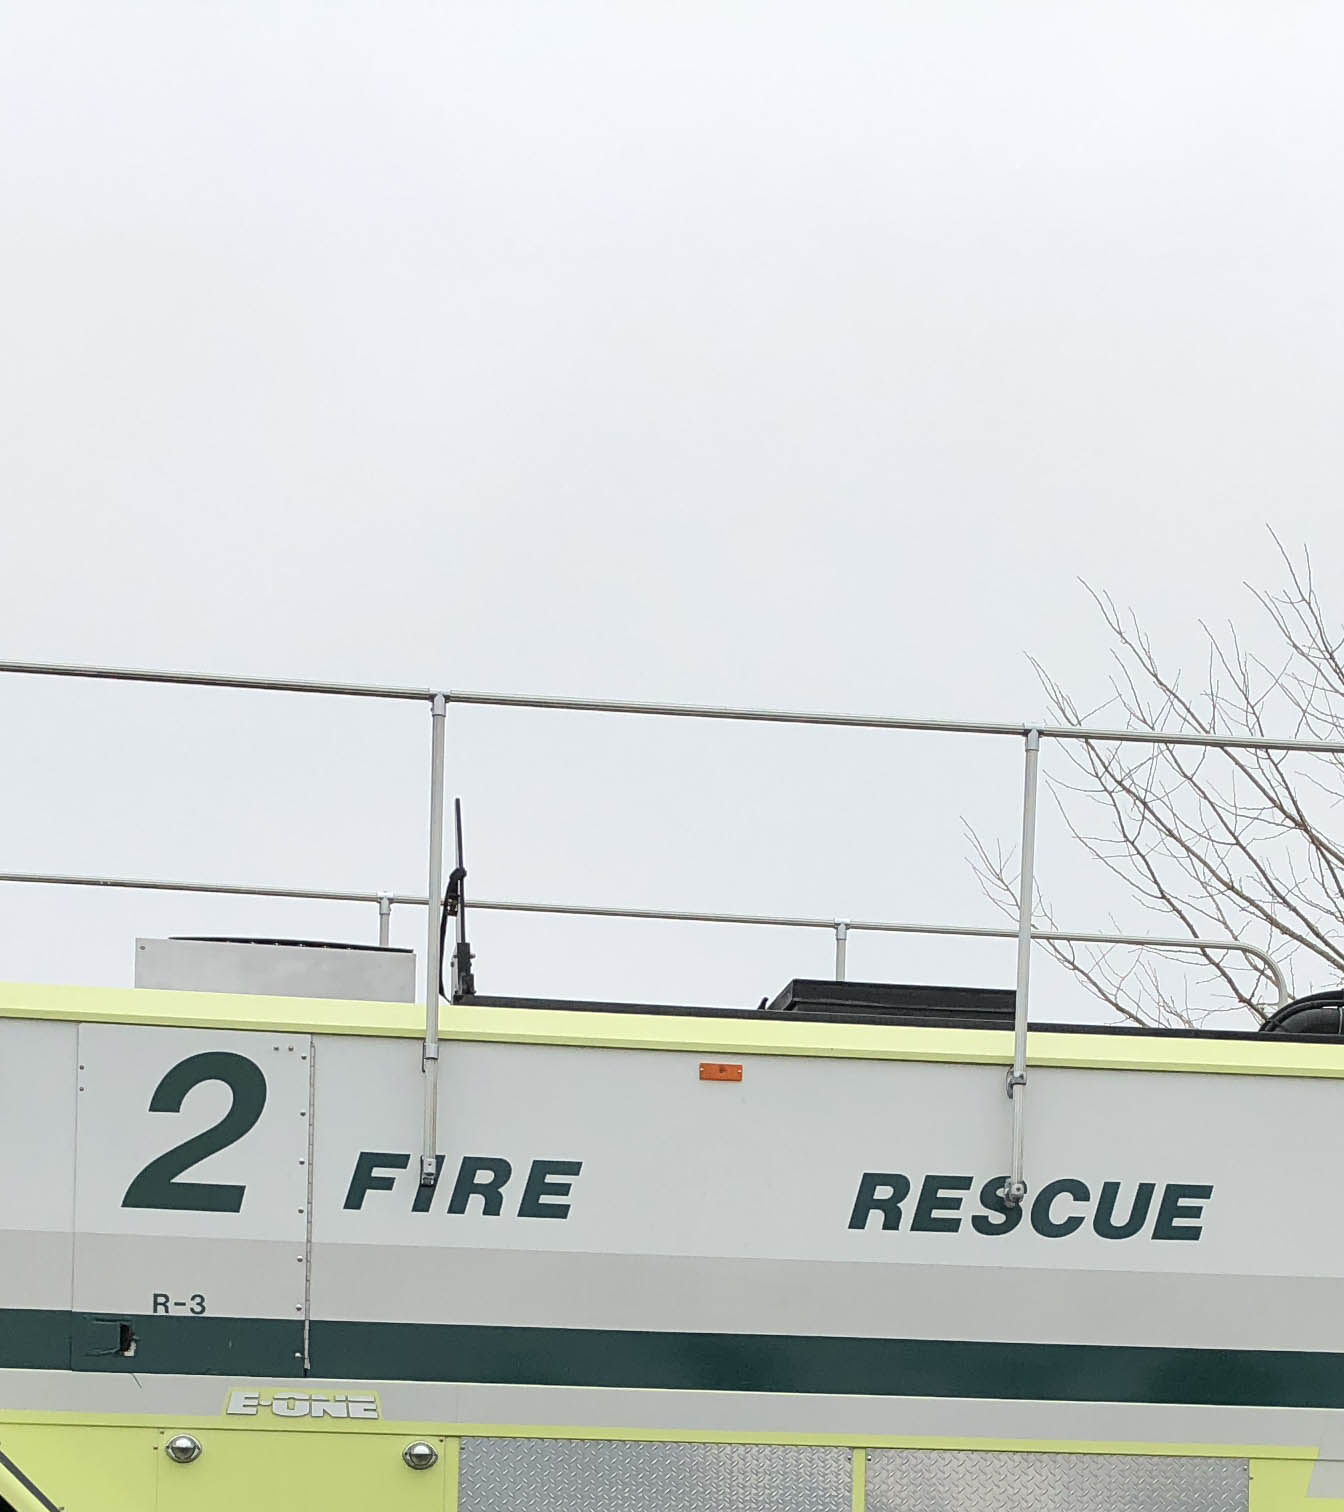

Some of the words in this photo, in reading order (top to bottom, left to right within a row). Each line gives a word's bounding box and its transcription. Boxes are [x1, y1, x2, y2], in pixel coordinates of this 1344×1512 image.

[121, 1051, 267, 1213] 2
[343, 1151, 582, 1219] FIRE
[848, 1172, 1214, 1241] RESCUE
[152, 1293, 206, 1315] R-3
[226, 1391, 379, 1420] E-ONE
